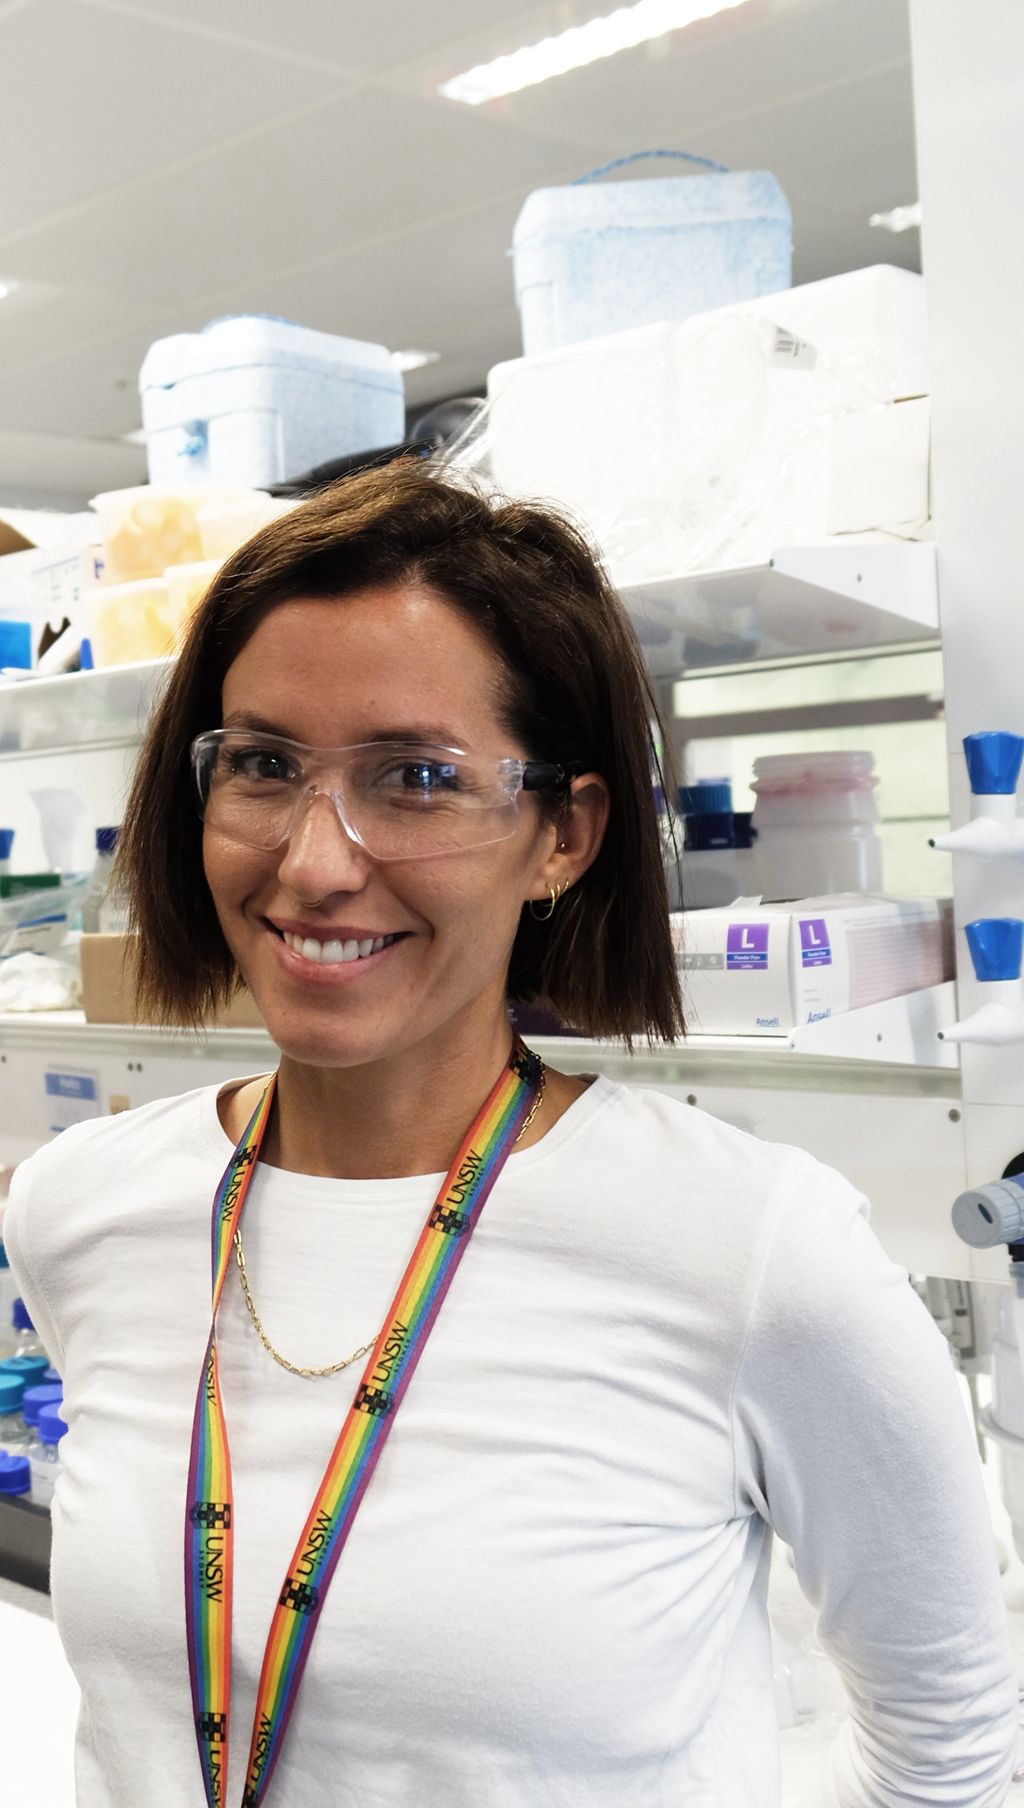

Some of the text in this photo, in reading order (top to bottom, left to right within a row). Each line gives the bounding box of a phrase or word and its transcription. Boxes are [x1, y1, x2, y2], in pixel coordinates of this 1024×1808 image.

[741, 928, 754, 949] L
[808, 925, 821, 945] L
[222, 1171, 245, 1222] UNSW
[446, 1149, 483, 1205] UNSW
[371, 1320, 409, 1382] UNSW
[205, 1536, 224, 1603] UNSW
[296, 1509, 333, 1576] UNSW
[251, 1712, 272, 1783] UNSW
